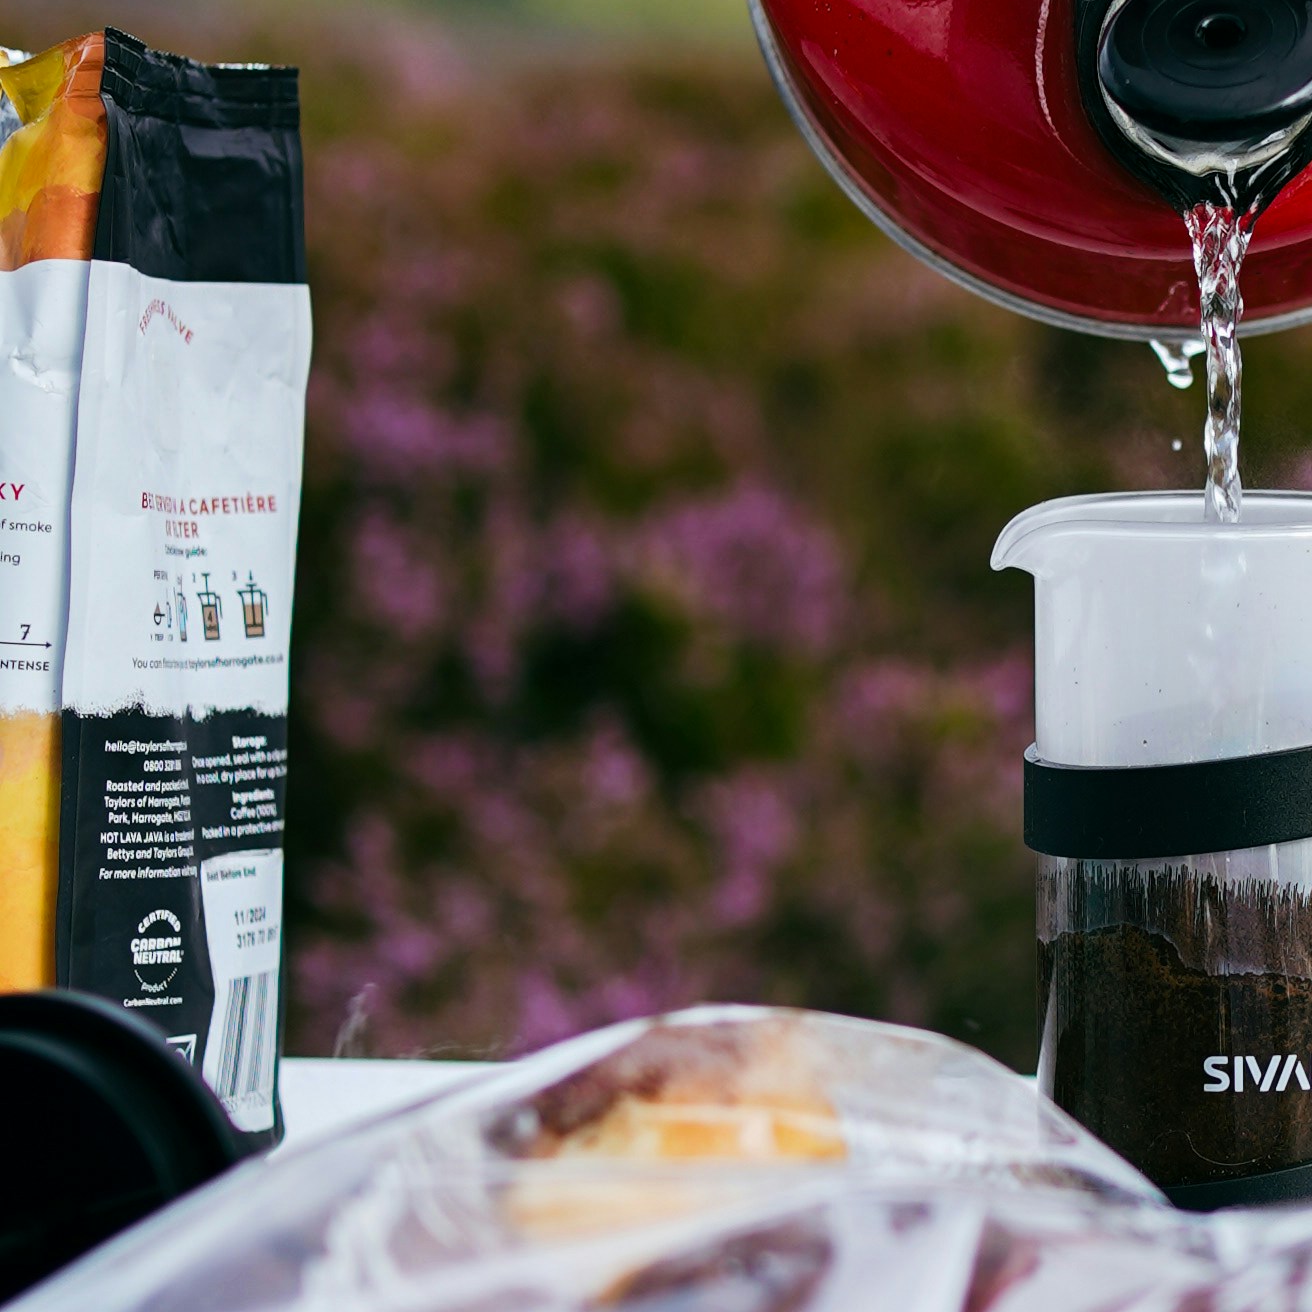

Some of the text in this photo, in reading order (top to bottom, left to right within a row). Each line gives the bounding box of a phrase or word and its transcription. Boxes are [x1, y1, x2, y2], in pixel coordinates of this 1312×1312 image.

[189, 492, 277, 515] CAFETIÈRE
[9, 521, 52, 533] smoke
[20, 624, 31, 640] 7
[132, 657, 147, 669] You
[143, 760, 164, 772] 0800
[220, 770, 234, 785] dry
[234, 768, 256, 783] place
[256, 766, 267, 779] for
[106, 780, 144, 792] Roasted
[145, 780, 161, 792] and
[104, 796, 136, 811] Taylors
[137, 795, 147, 808] of
[108, 812, 131, 825] Park,
[230, 806, 256, 820] Coffee
[100, 832, 119, 844] HOT
[119, 832, 142, 844] LAVA
[143, 831, 163, 843] JAVA
[164, 831, 169, 843] is
[170, 833, 175, 843] a
[107, 848, 135, 862] Bettys
[136, 848, 152, 860] and
[153, 846, 177, 862] Taylors
[98, 868, 113, 880] For
[113, 869, 137, 879] more
[137, 866, 181, 879] information
[243, 866, 256, 877] End
[138, 909, 181, 934] CERTIFIED
[130, 936, 181, 953] CARBON
[123, 996, 183, 1007] CarbonNeutral.com
